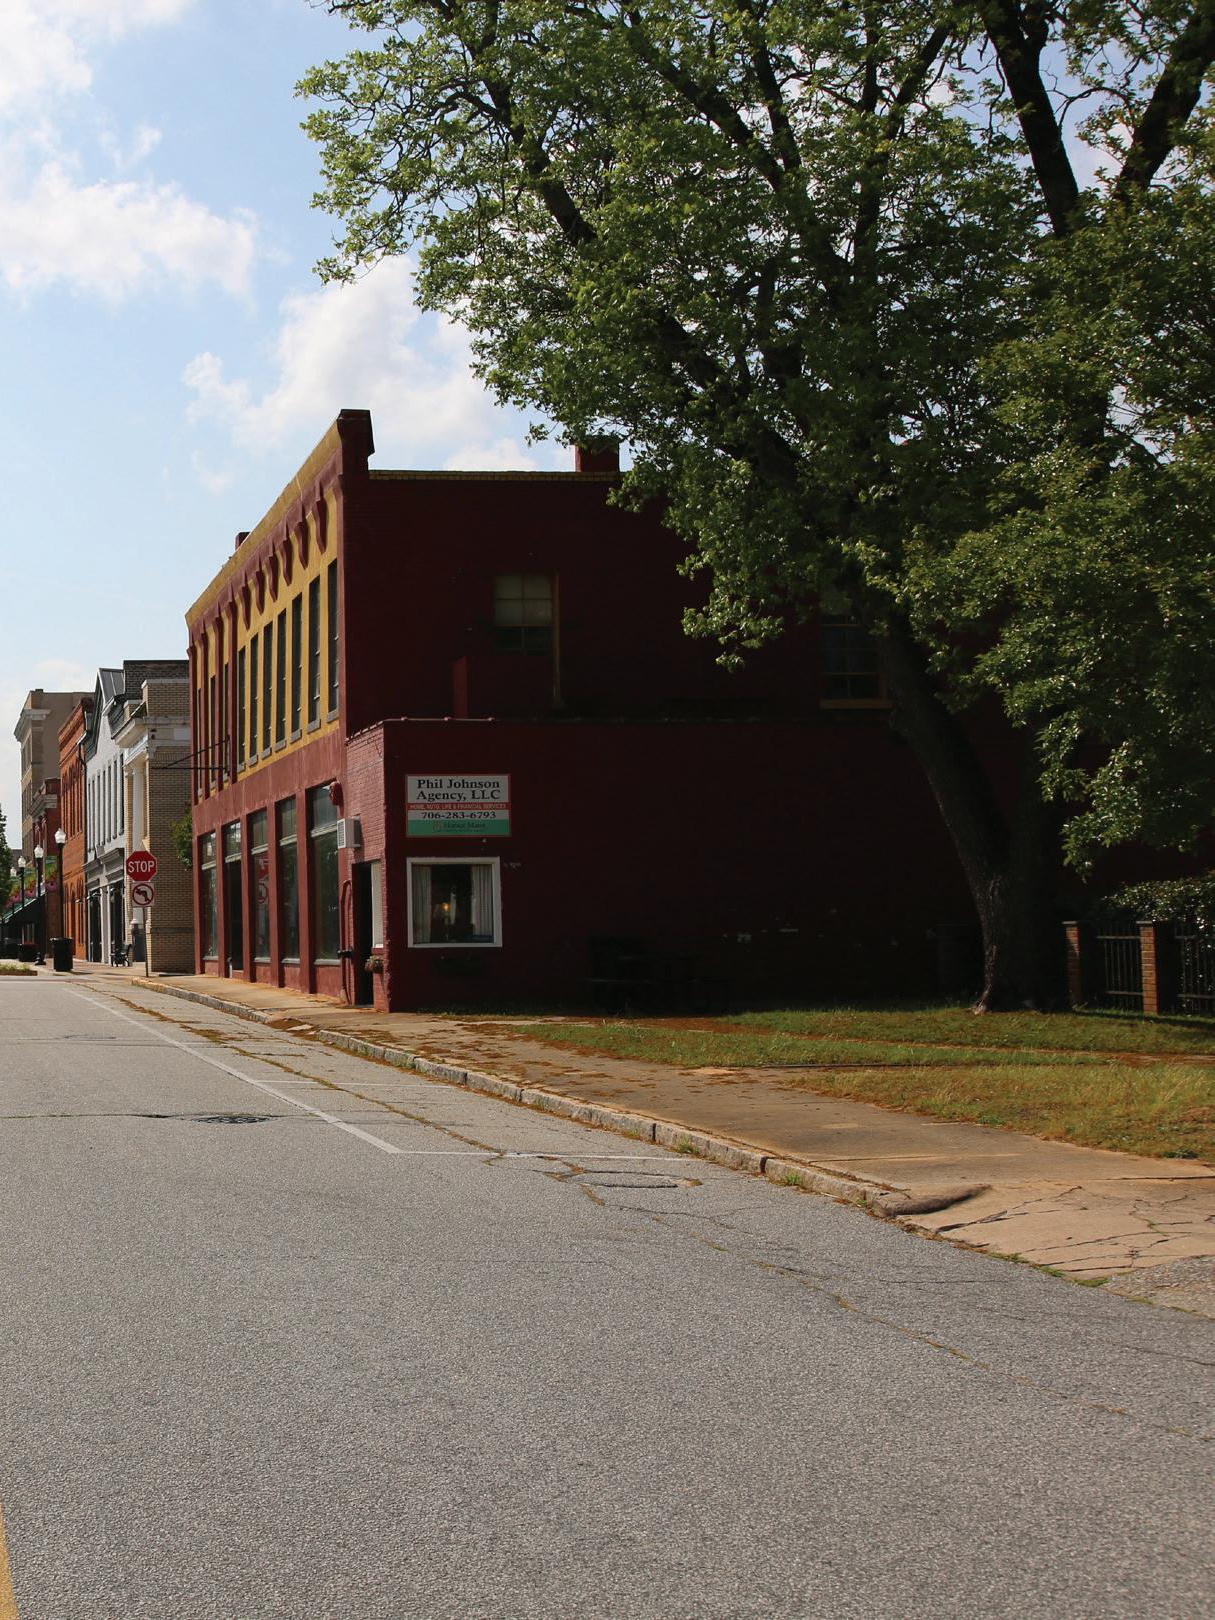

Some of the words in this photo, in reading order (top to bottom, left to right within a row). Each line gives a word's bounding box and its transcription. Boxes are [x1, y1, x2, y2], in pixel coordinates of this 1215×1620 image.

[417, 779, 443, 789] Phil
[447, 779, 500, 789] Johnson
[416, 790, 467, 802] Agency,
[471, 790, 501, 800] LLC
[421, 811, 496, 819] 706-283-6793
[128, 861, 154, 873] STOP
